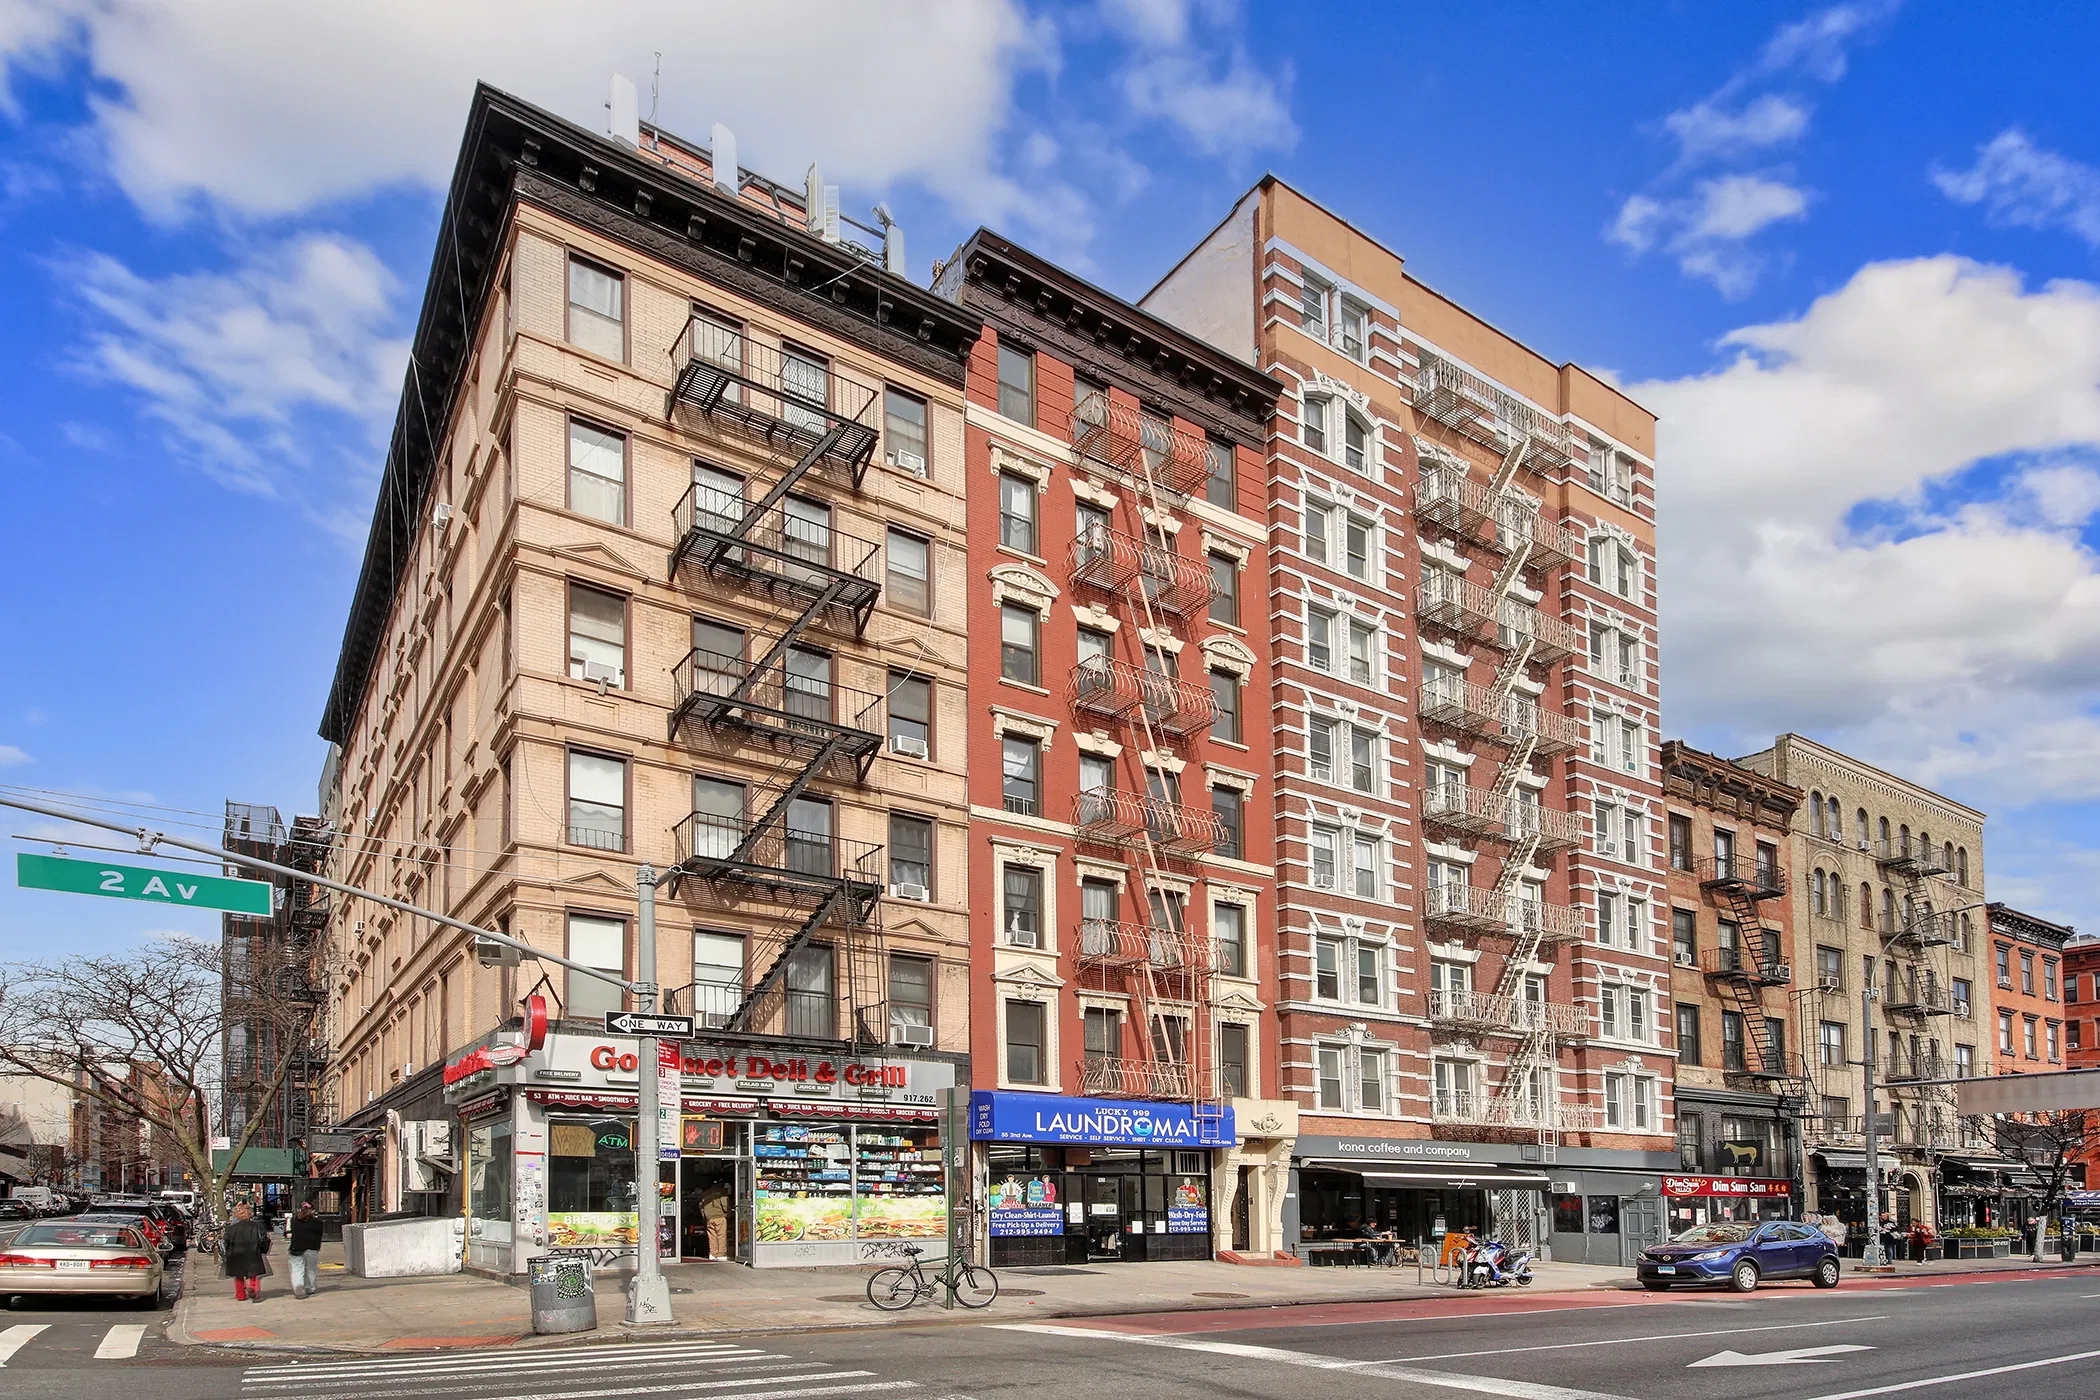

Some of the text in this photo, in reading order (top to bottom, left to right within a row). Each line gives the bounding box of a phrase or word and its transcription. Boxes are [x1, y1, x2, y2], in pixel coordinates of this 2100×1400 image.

[100, 871, 198, 900] 2 Av
[620, 1018, 683, 1031] ONE WAY
[591, 1045, 739, 1078] Gomet
[746, 1055, 808, 1082] Deli
[815, 1061, 838, 1084] &
[844, 1063, 907, 1088] Grill
[660, 1068, 665, 1077] 3
[660, 1110, 665, 1118] 2
[980, 1112, 989, 1120] DRY
[1095, 1107, 1150, 1117] LUCKY 999
[598, 1136, 628, 1148] ATM
[1338, 1141, 1470, 1158] kona coffee and company
[1712, 1180, 1766, 1193] Dim Sum Sam
[564, 1215, 634, 1225] BREAKFAST
[991, 1212, 1004, 1220] Dry
[1168, 1210, 1207, 1220] Wash-Dry-Fold
